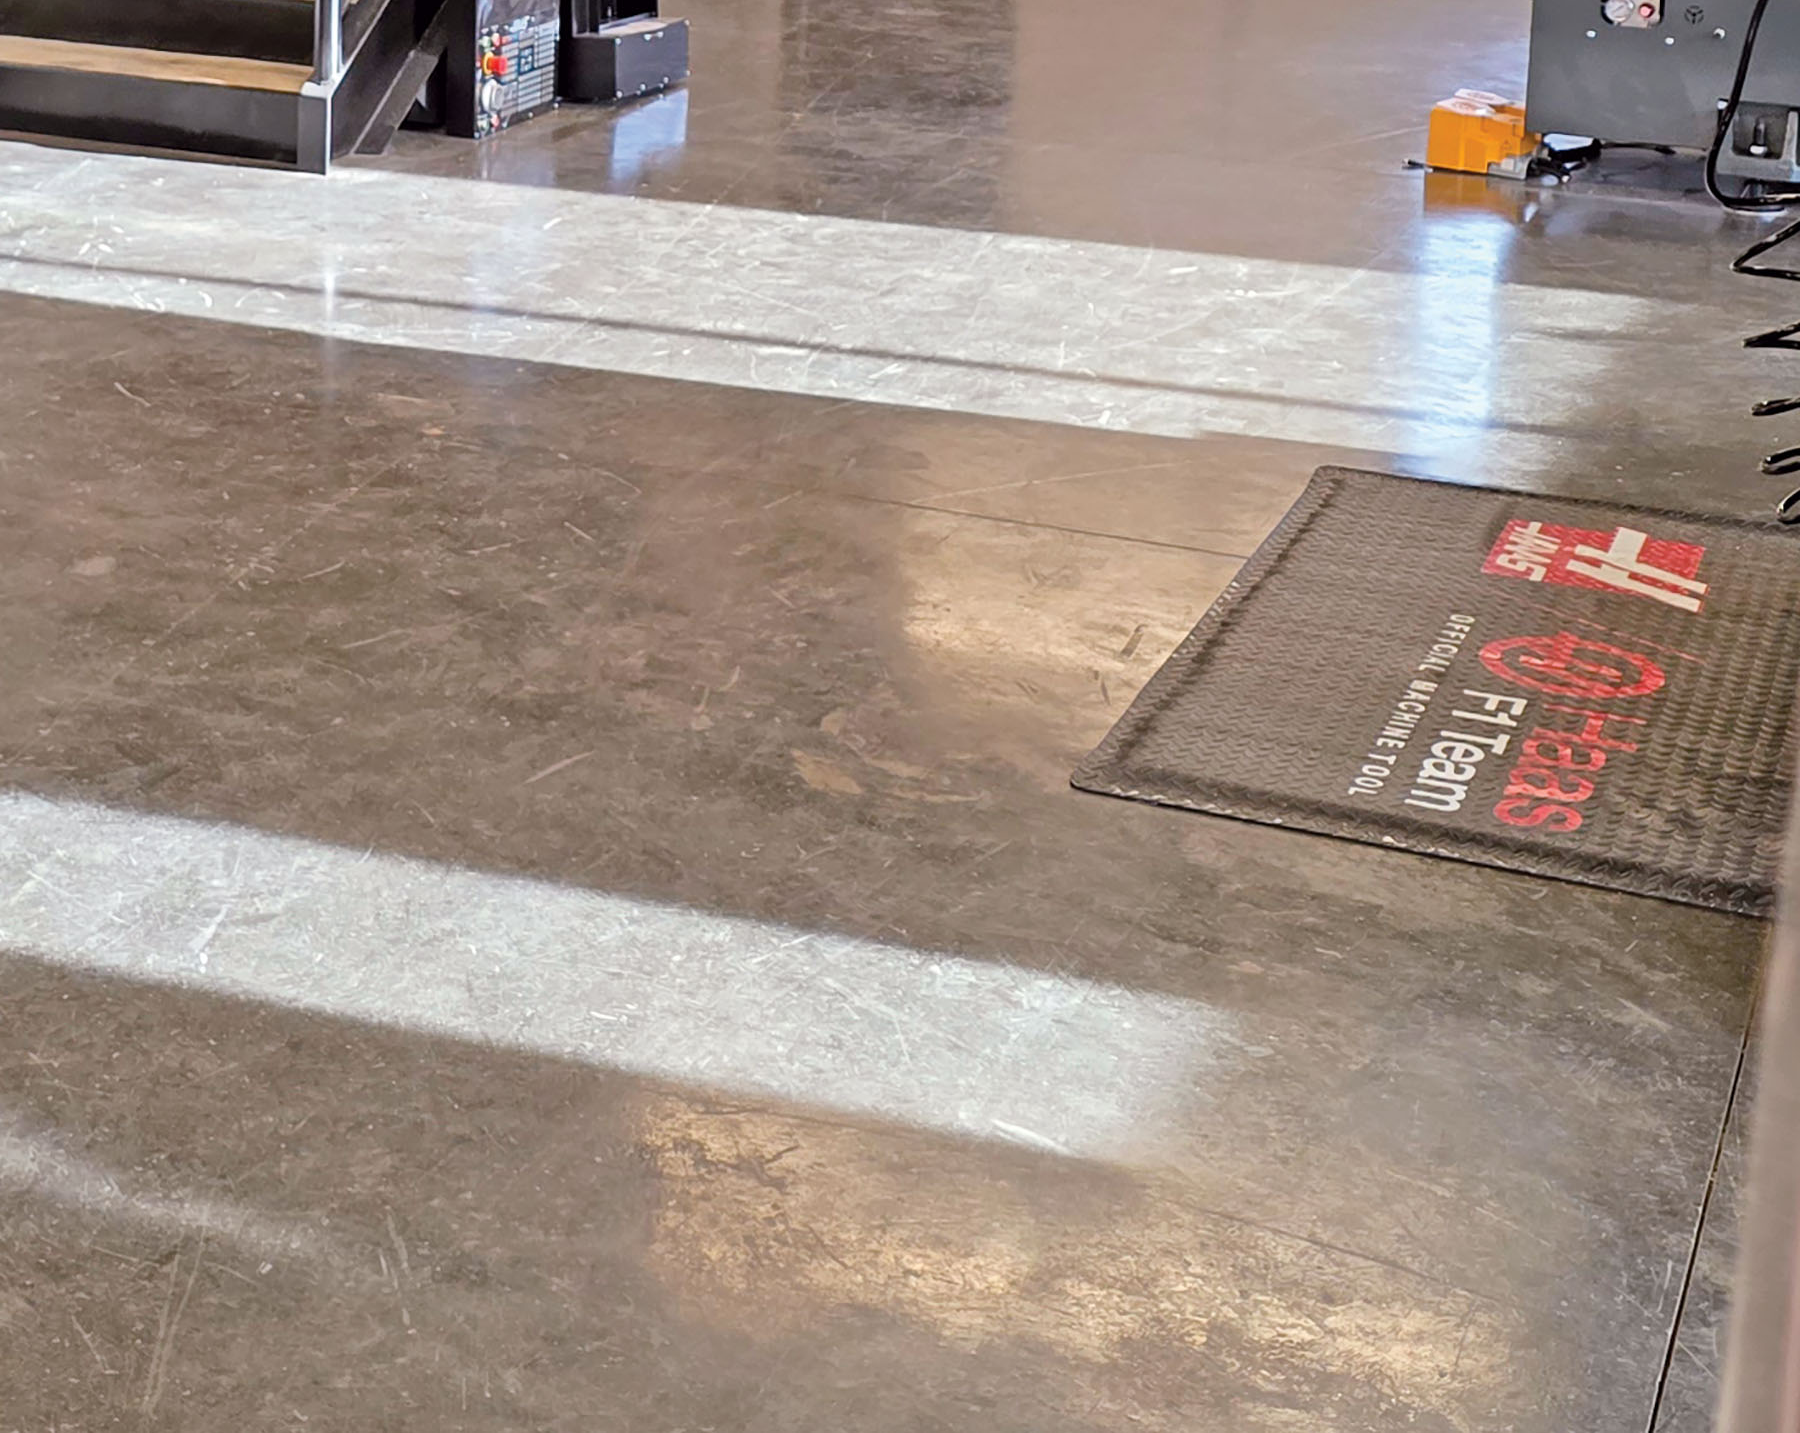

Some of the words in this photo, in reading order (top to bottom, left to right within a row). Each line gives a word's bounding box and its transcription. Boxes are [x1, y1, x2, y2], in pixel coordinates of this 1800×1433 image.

[1418, 613, 1476, 673] OFFICIAL
[1376, 679, 1440, 750] MACHINE
[1451, 688, 1528, 727] F1
[1347, 753, 1398, 795] TOOL
[1404, 730, 1511, 813] Team
[1493, 703, 1647, 832] Haas
